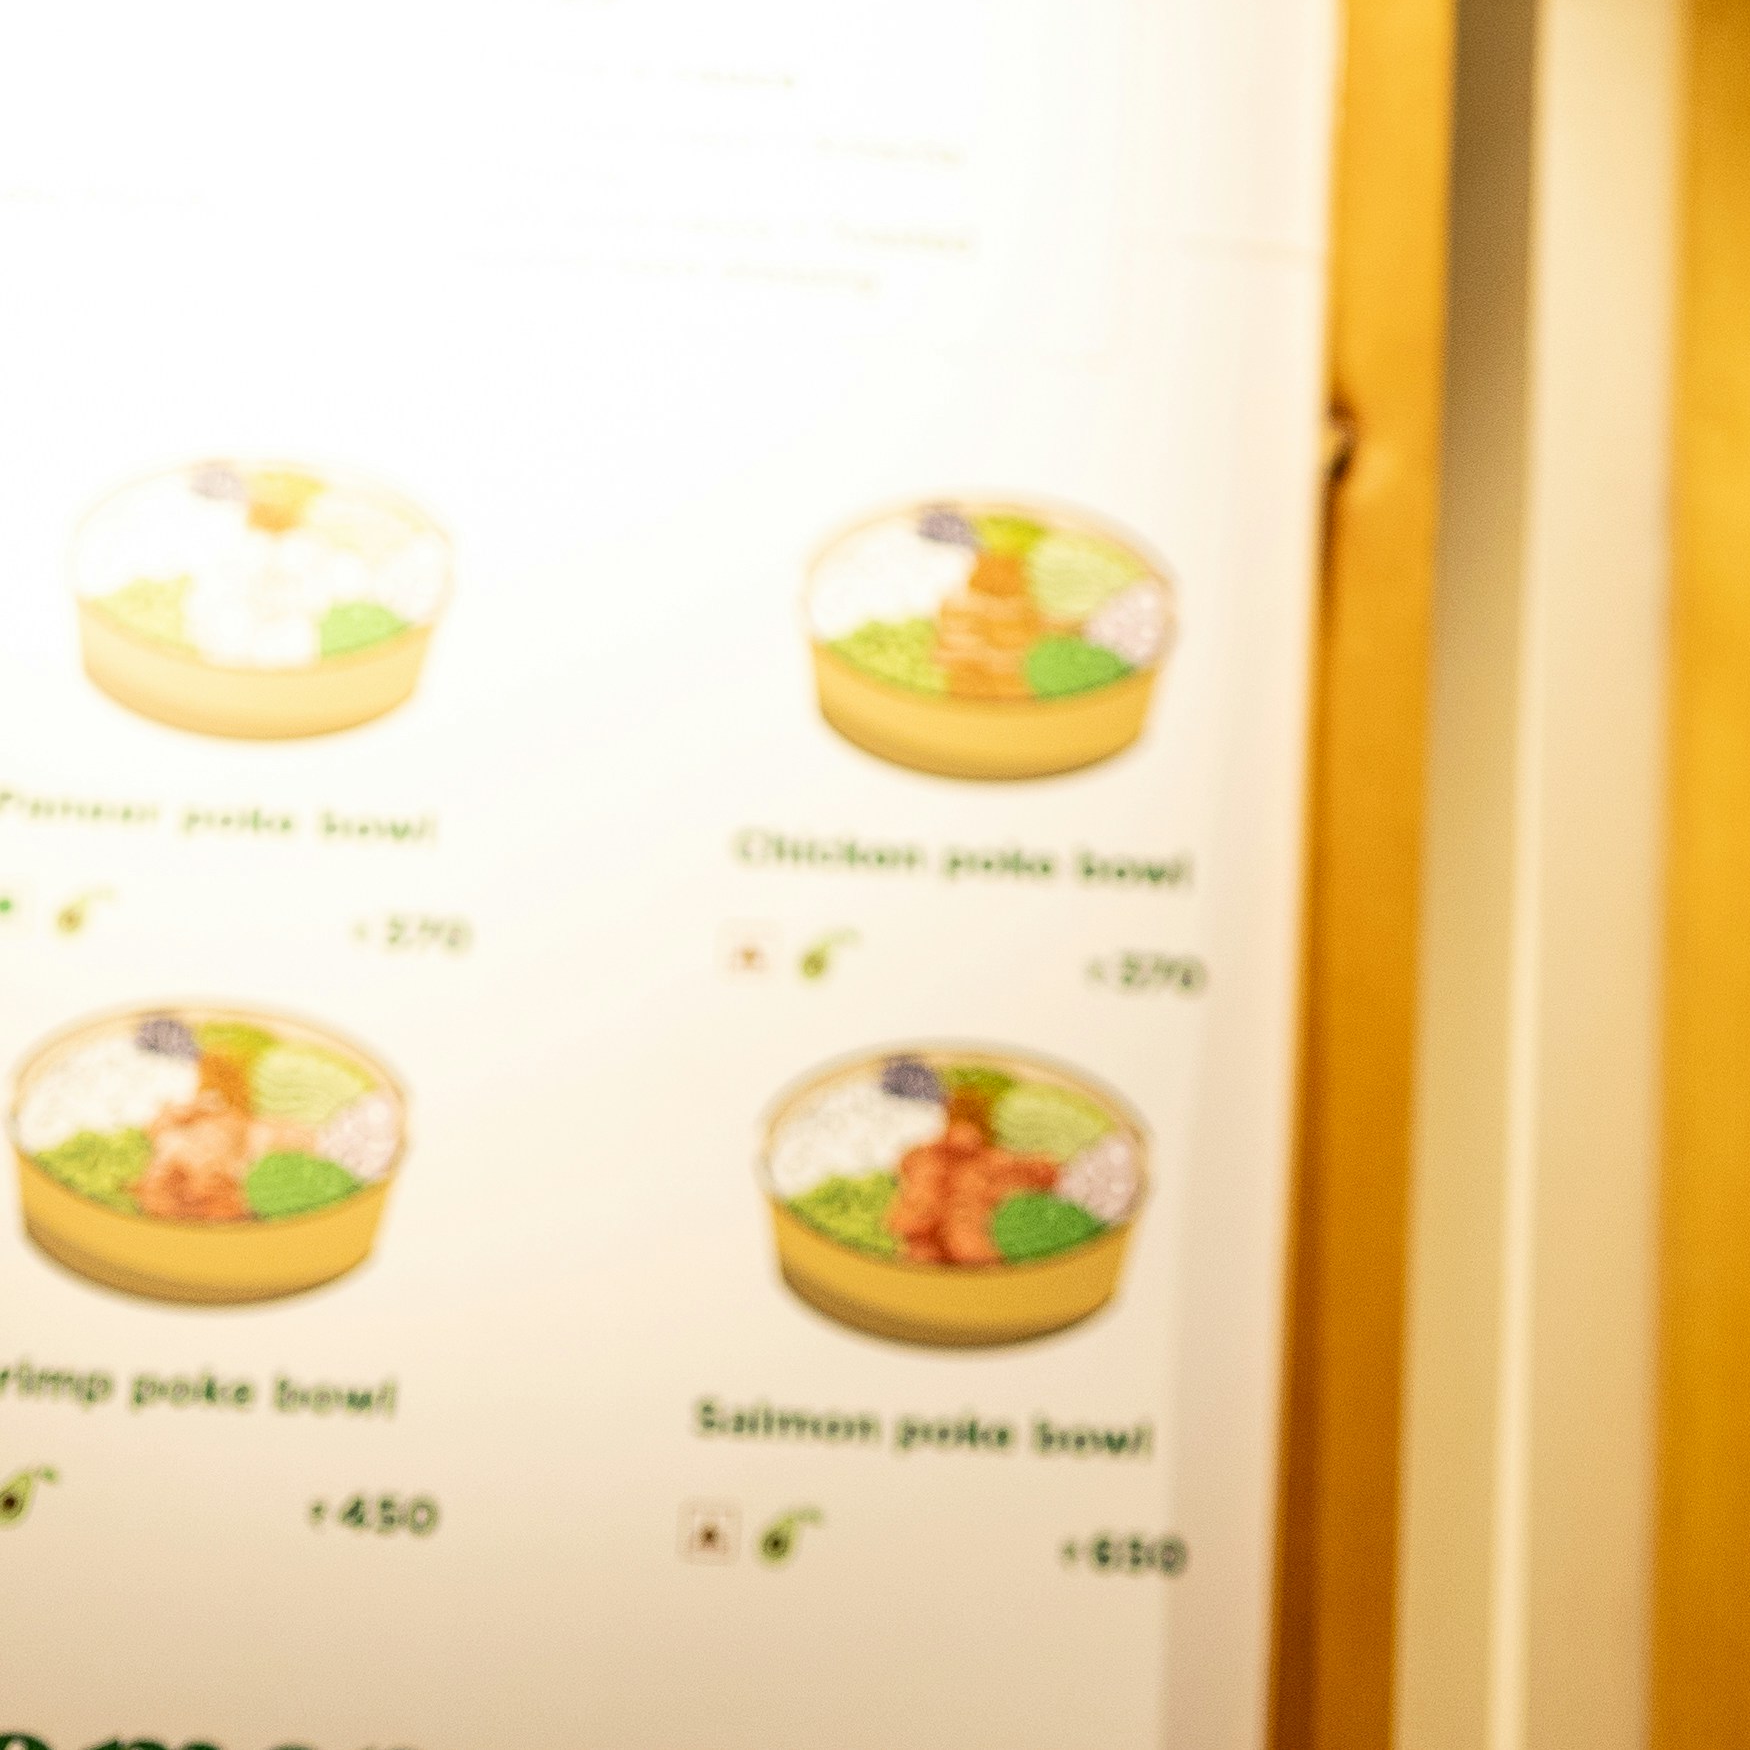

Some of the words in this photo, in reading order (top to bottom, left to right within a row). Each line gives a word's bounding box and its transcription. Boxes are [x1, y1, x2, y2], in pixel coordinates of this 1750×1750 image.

[129, 1373, 256, 1411] poke
[272, 1376, 397, 1416] bowl
[696, 1399, 882, 1444] Salmon
[1032, 1420, 1153, 1458] bowl
